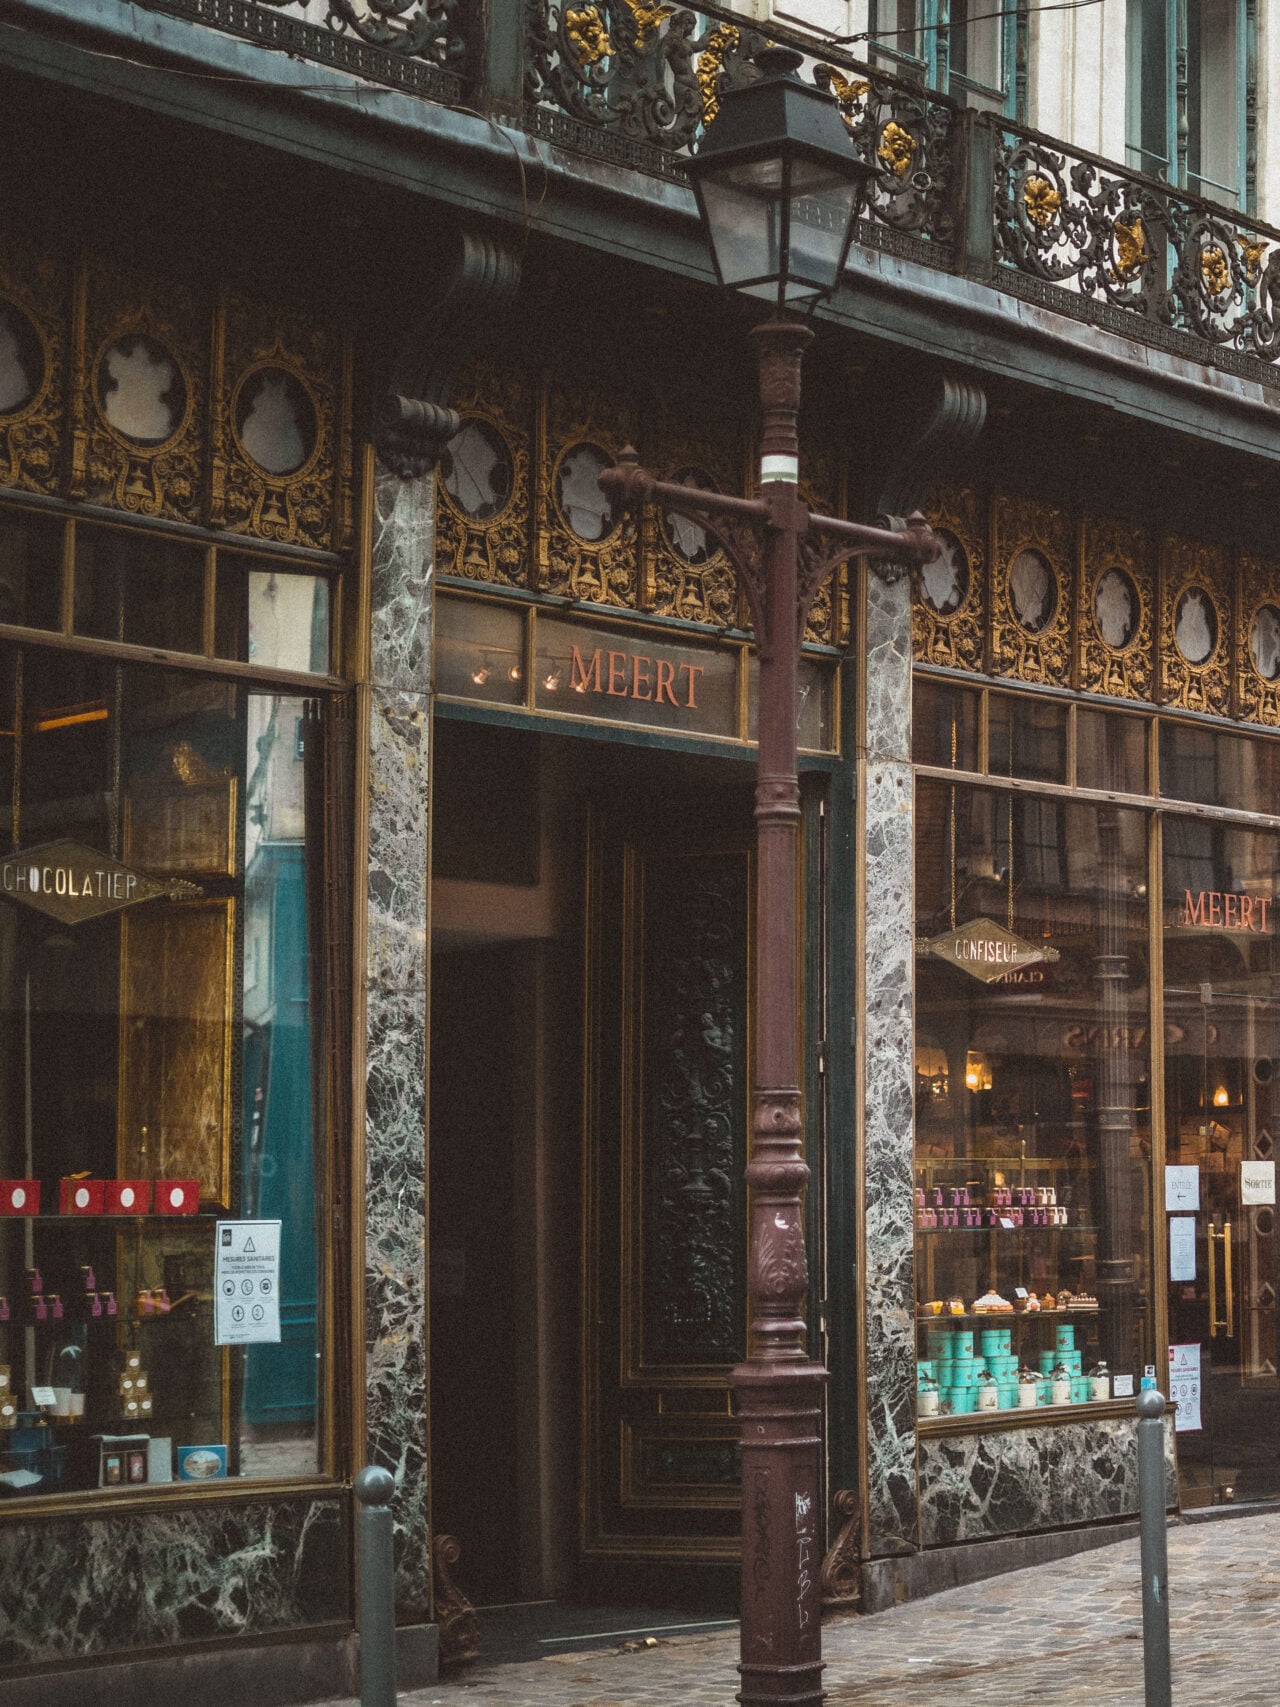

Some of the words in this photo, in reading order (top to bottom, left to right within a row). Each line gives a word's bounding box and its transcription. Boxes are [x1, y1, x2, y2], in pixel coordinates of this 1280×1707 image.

[569, 644, 705, 708] MEERT
[3, 864, 137, 900] CHOCOLATIER
[1184, 888, 1273, 934] MEERT
[955, 939, 1019, 963] CONFISEUR
